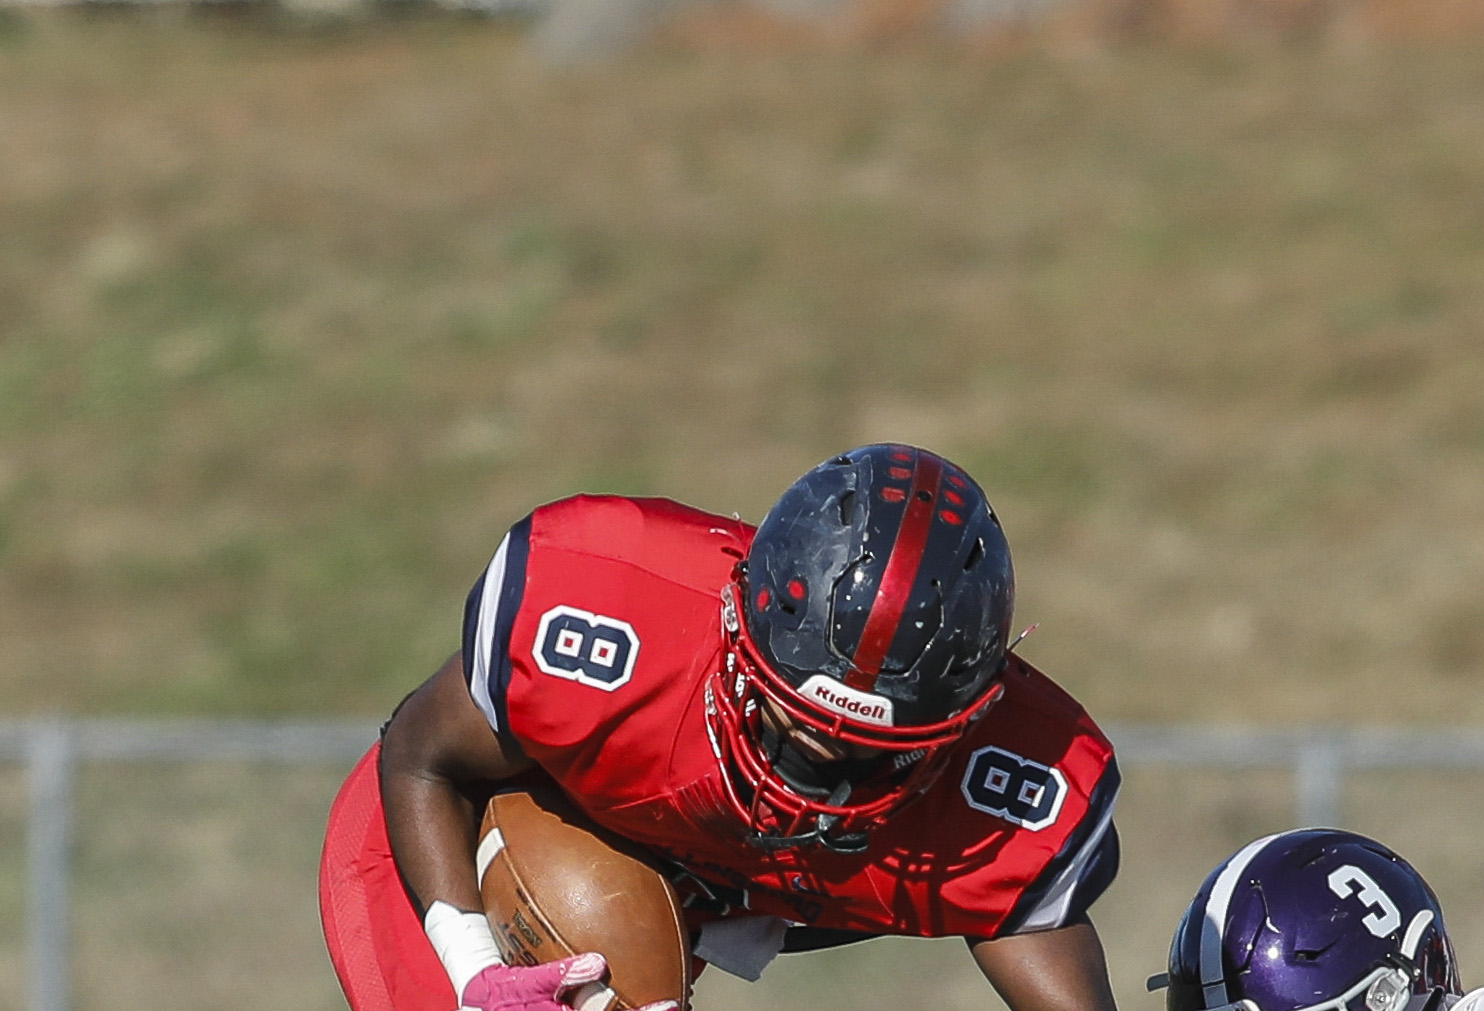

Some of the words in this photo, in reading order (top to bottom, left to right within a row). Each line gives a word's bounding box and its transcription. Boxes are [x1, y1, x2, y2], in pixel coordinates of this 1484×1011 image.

[532, 605, 641, 692] 8
[814, 685, 886, 720] Riddell
[960, 745, 1070, 832] 8
[1327, 864, 1401, 939] 3
